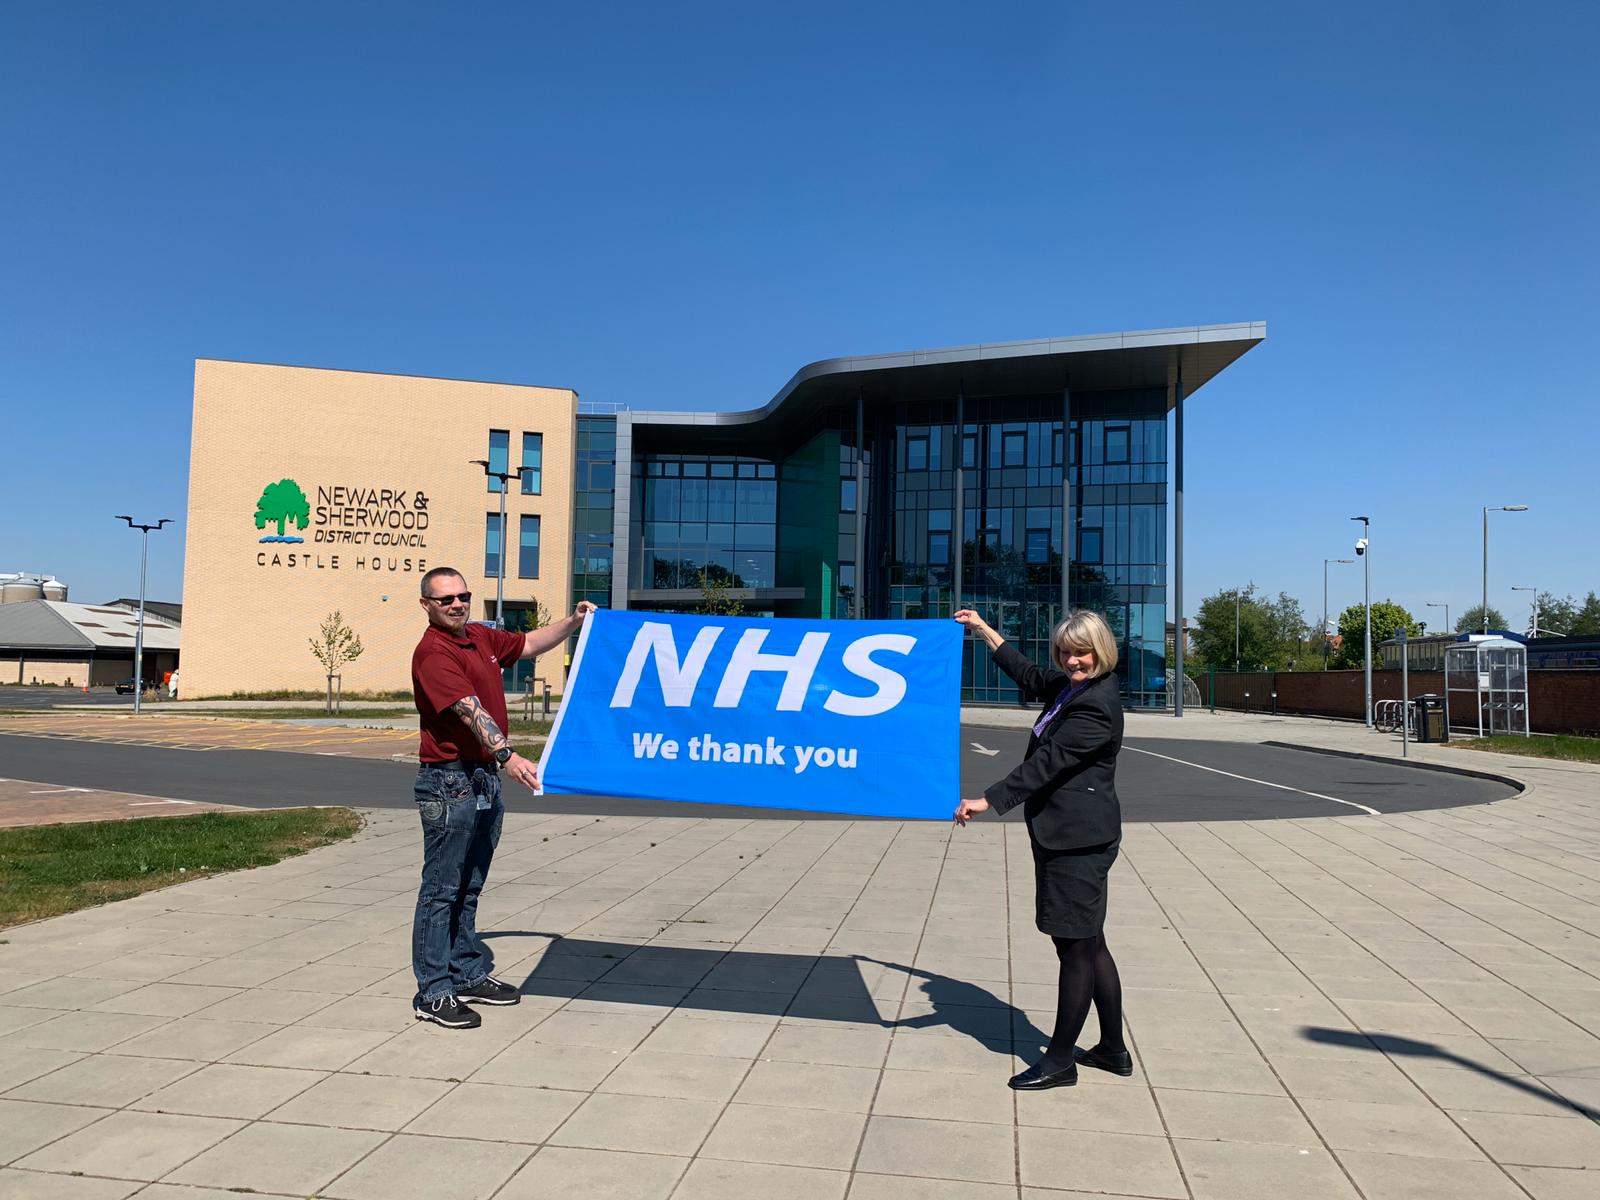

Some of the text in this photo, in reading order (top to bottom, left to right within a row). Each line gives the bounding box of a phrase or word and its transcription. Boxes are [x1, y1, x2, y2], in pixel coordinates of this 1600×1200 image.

[317, 485, 429, 510] NEWARK &
[315, 506, 428, 530] SHERWOOD
[314, 529, 427, 548] DISTRICT COUNCIL
[256, 552, 426, 572] CASTLE HOUSE
[609, 621, 918, 717] NHS
[632, 732, 858, 774] We thank you
